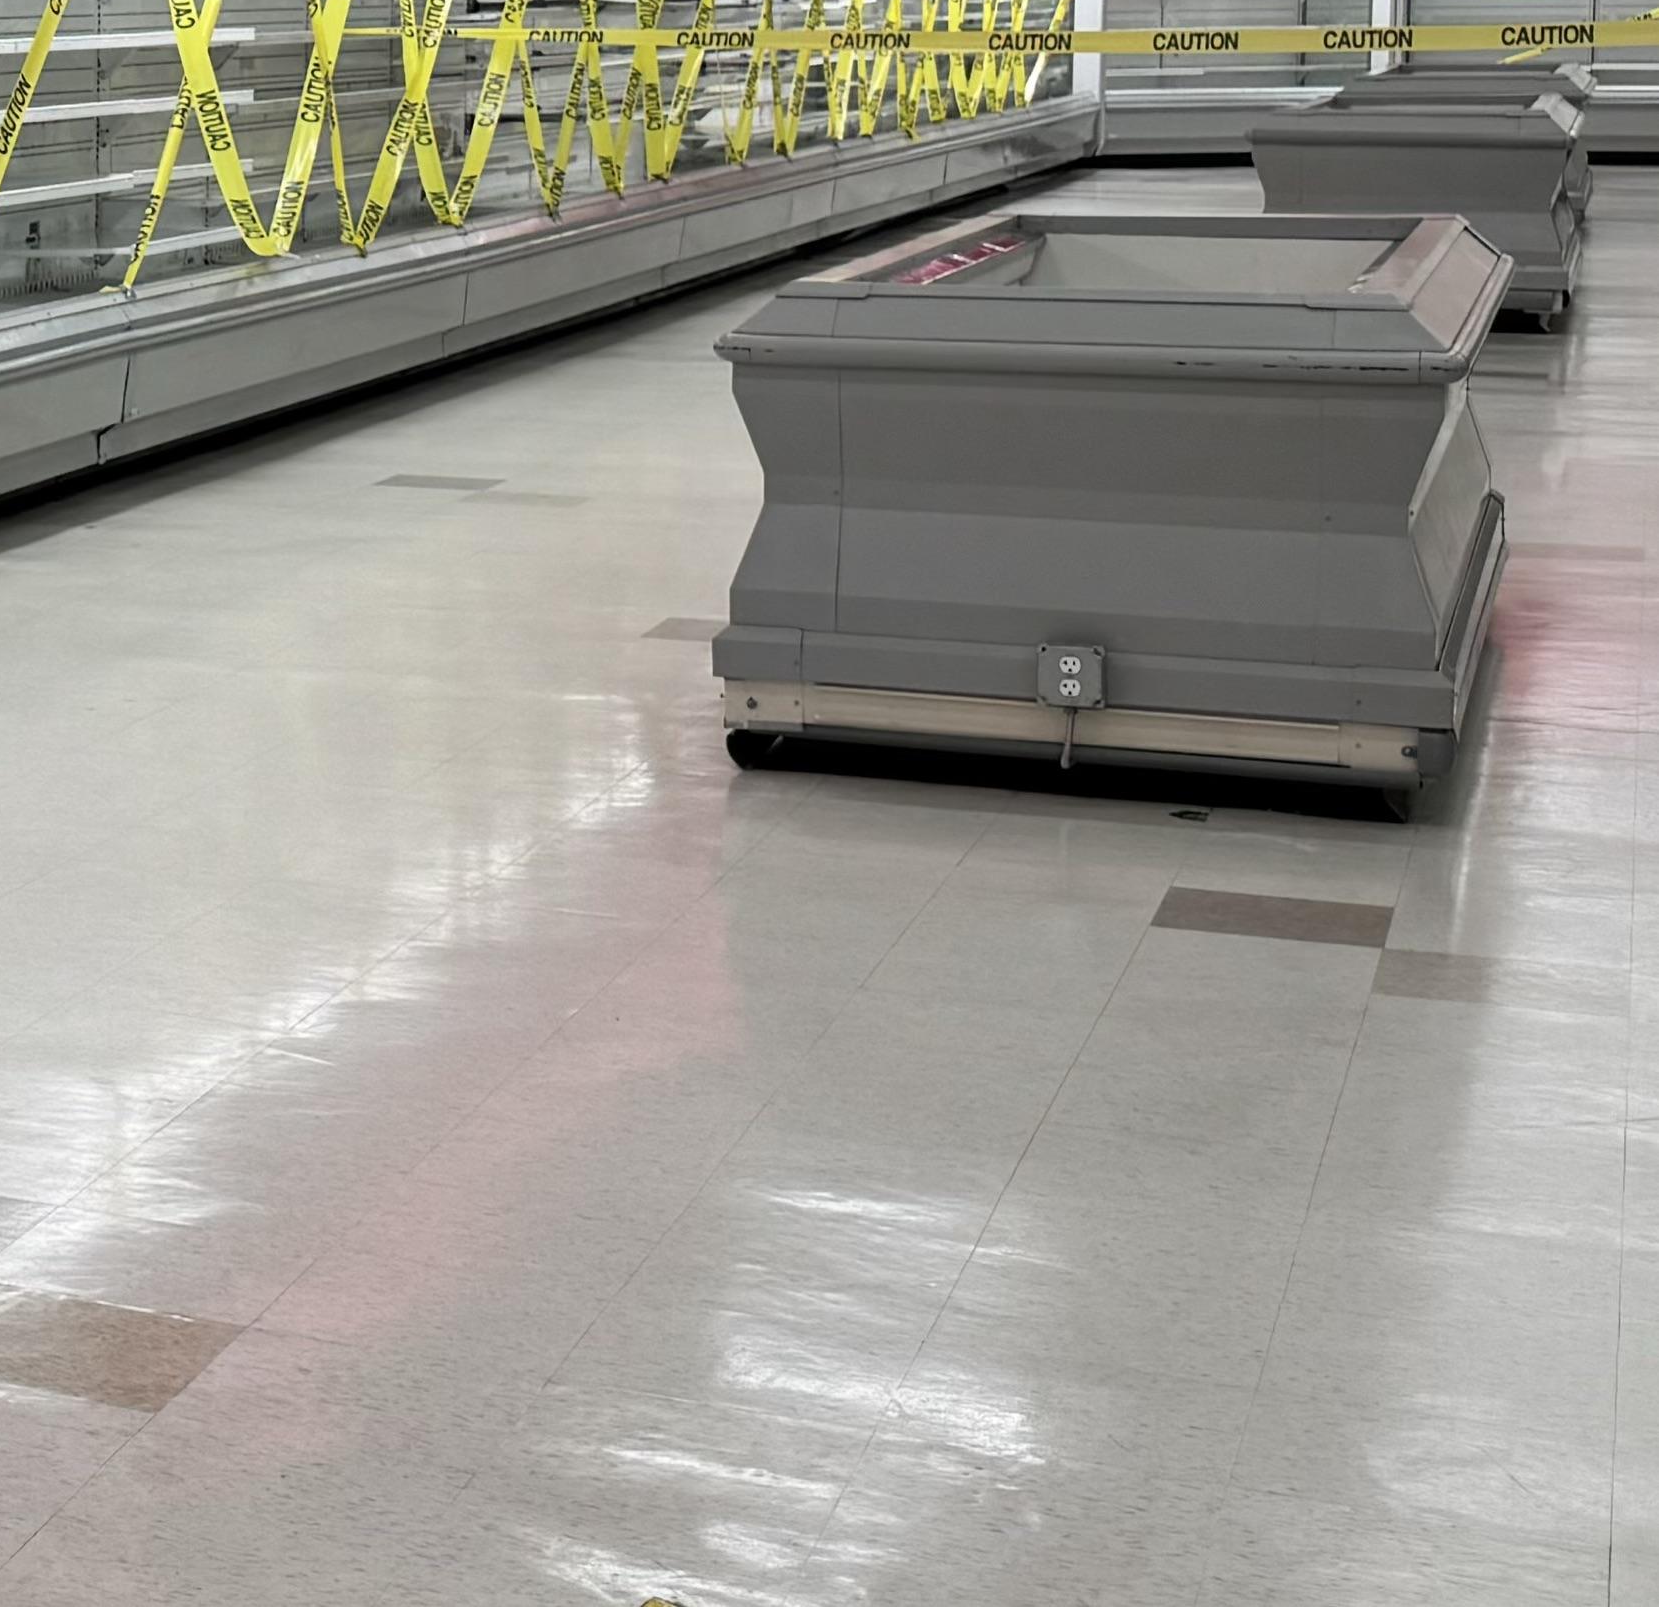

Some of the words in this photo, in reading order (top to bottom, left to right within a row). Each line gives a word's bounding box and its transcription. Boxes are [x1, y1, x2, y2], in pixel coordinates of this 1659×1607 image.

[529, 30, 604, 43] CAUTION
[677, 31, 755, 48] CAUTION
[830, 33, 911, 50] CAUTION
[988, 33, 1072, 51] CAUTION
[1152, 32, 1239, 52] CAUTION
[1323, 29, 1414, 50] CAUTION
[1500, 24, 1595, 46] CAUTION
[478, 72, 506, 128] CAUTION
[566, 62, 586, 120] CAUTION
[385, 98, 419, 158] CAUTION
[273, 180, 305, 238] CAUTION
